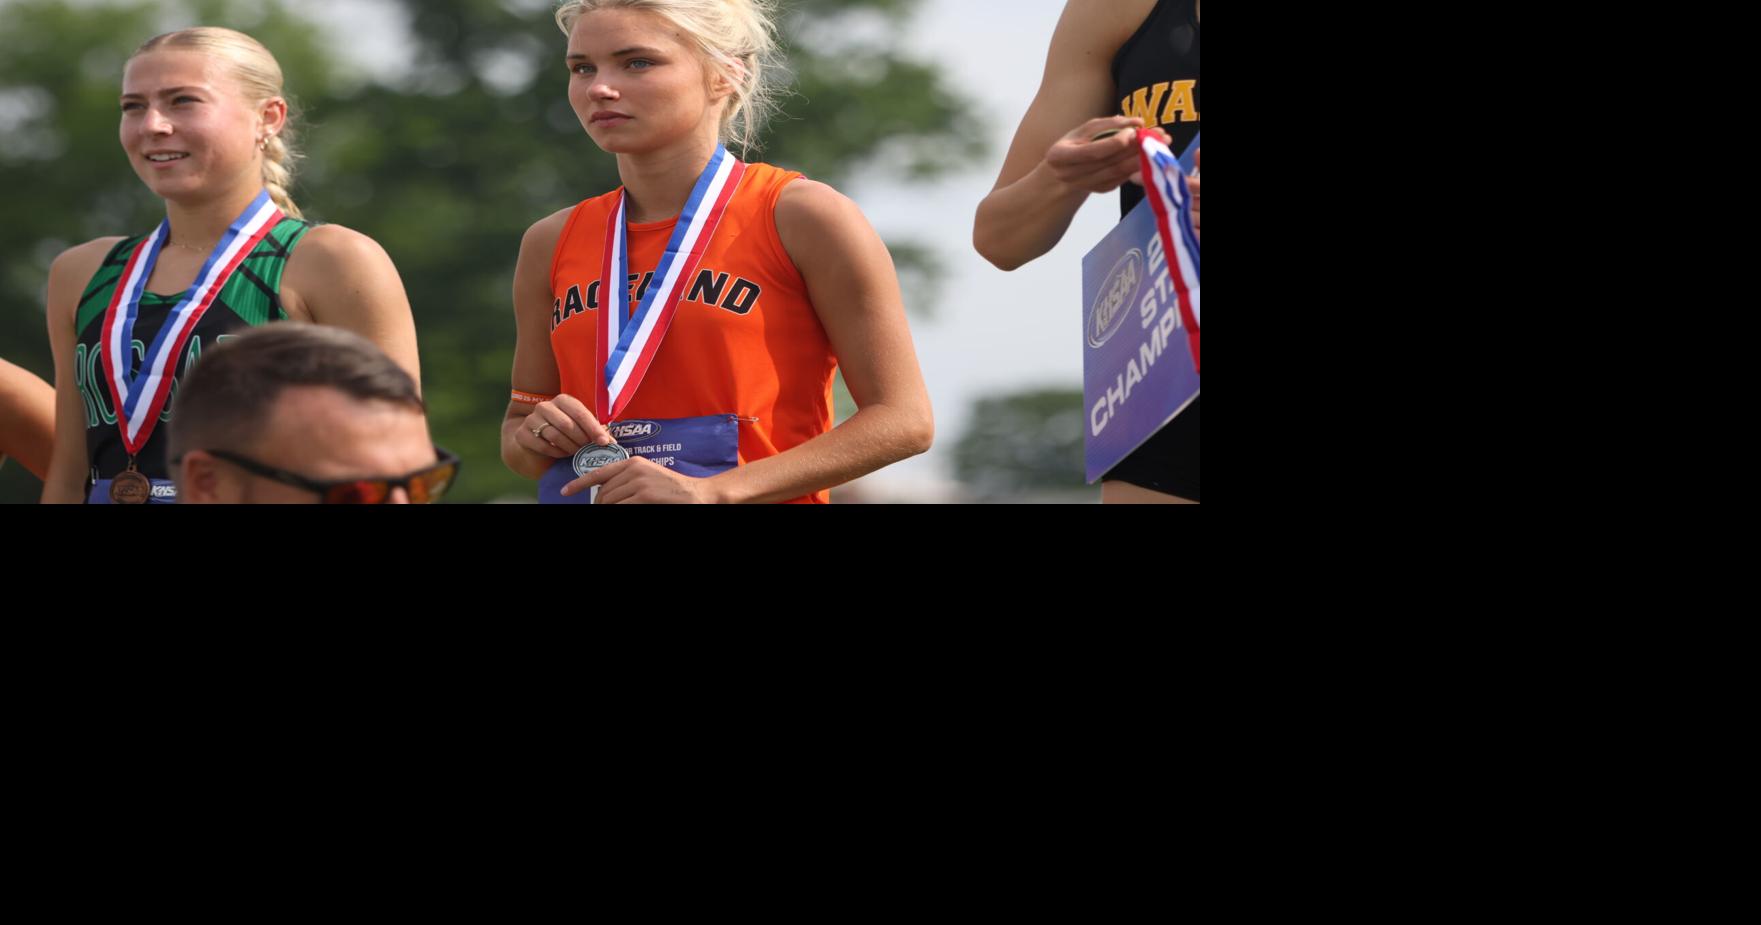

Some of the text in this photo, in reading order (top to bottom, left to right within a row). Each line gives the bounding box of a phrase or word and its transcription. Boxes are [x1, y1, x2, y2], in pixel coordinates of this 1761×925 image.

[1121, 79, 1200, 129] WA
[634, 445, 655, 454] TRACK
[656, 444, 662, 453] &
[662, 443, 682, 452] FIELD
